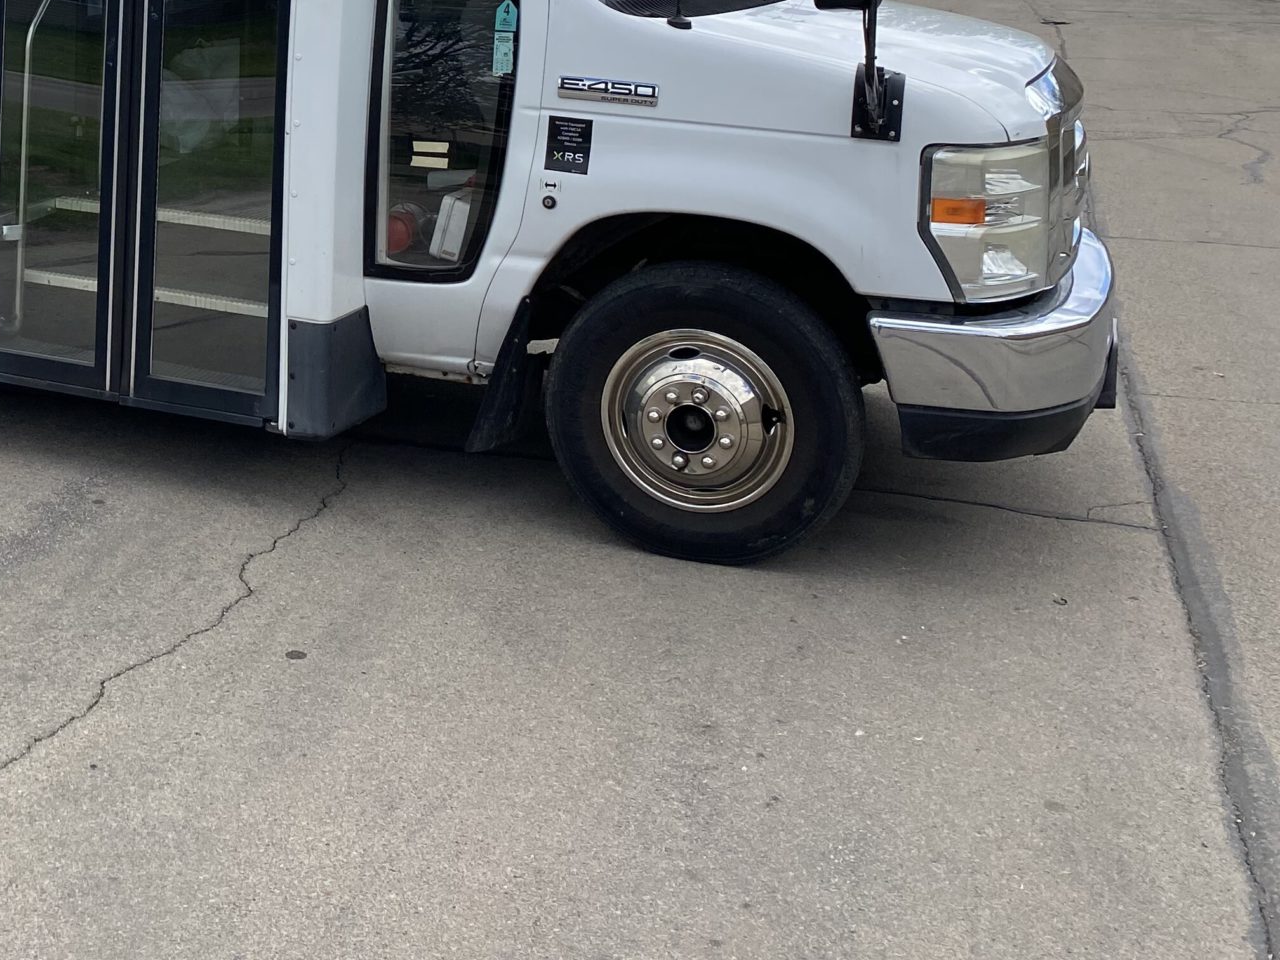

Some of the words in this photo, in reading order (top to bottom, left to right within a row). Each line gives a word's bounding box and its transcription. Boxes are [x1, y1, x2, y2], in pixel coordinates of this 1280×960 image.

[503, 3, 510, 16] 4
[558, 77, 658, 98] E-450
[553, 150, 584, 164] XRS
